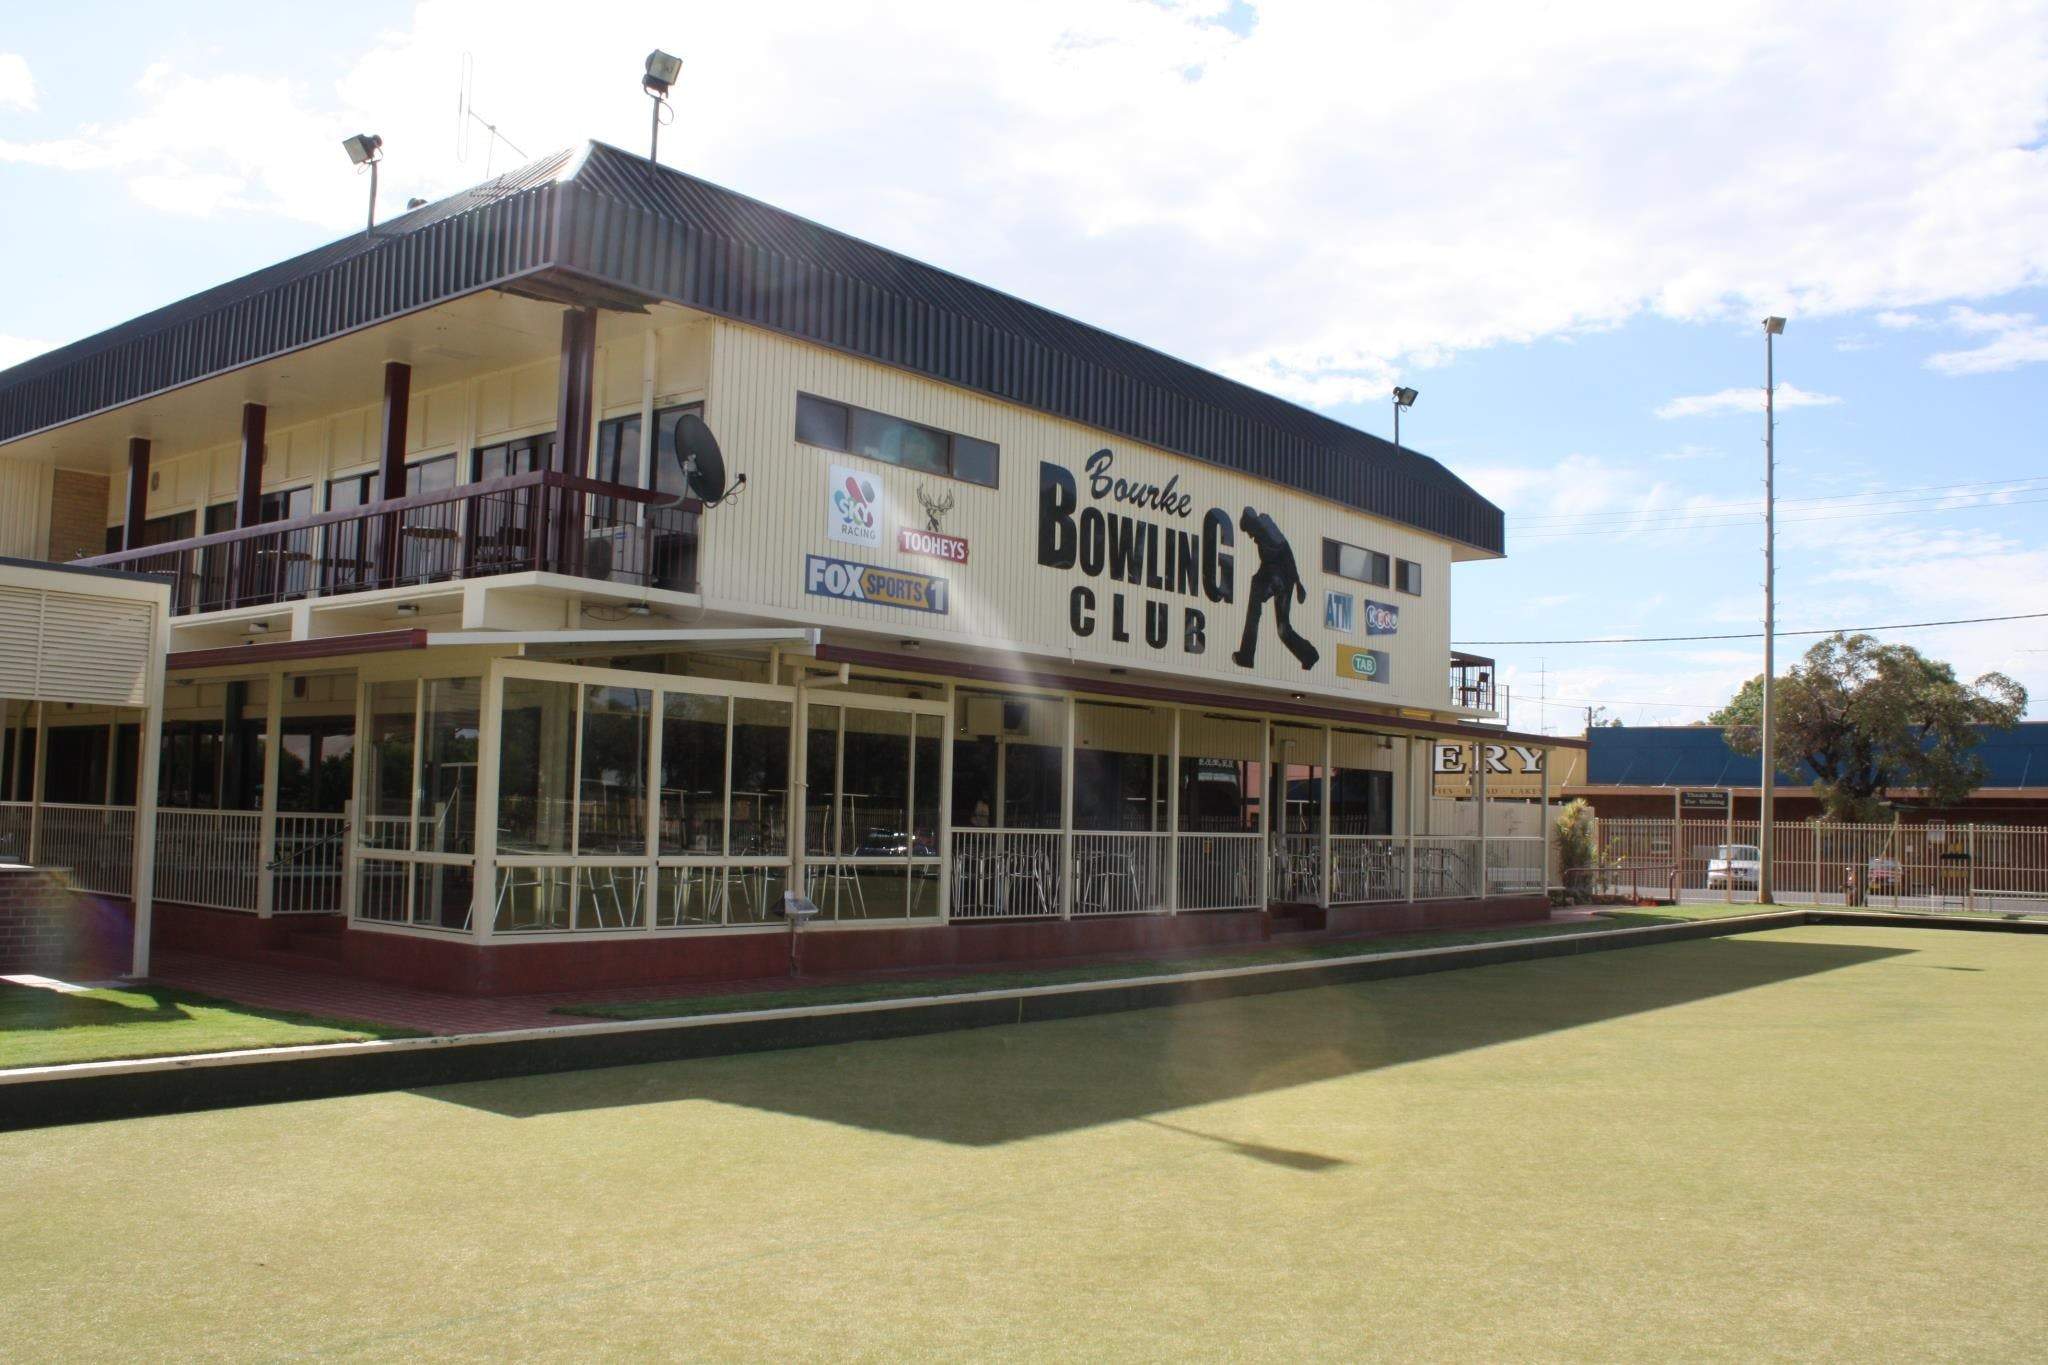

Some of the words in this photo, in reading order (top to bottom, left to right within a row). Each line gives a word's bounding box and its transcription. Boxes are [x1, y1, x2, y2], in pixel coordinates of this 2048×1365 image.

[1085, 448, 1192, 518] Bourke
[841, 524, 876, 539] RACING
[902, 530, 965, 561] TOOHEYS
[1038, 460, 1234, 604] BOWLING
[809, 558, 864, 599] FOX
[867, 575, 922, 601] SPORTS
[930, 581, 944, 610] 1
[1070, 586, 1205, 655] CLUB
[1355, 658, 1373, 671] TAB
